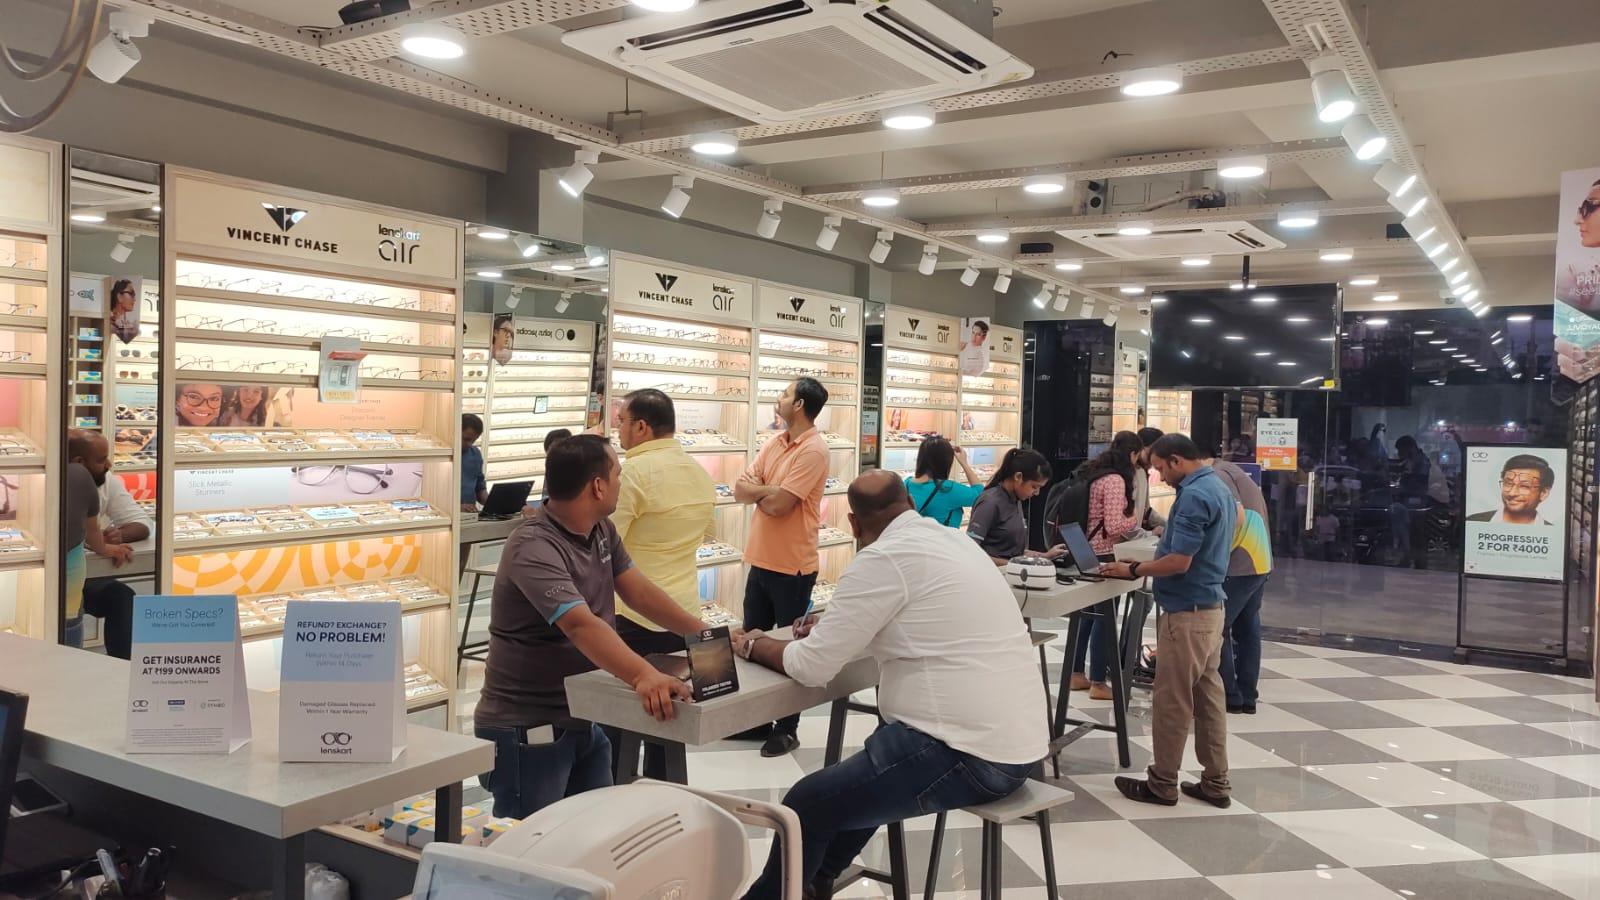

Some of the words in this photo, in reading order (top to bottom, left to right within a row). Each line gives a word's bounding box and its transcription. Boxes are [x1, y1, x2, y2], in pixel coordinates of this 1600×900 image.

[227, 227, 290, 247] VINCENT
[295, 237, 338, 254] CHASE
[378, 239, 420, 265] air
[638, 290, 670, 303] VINCENT
[671, 296, 693, 306] CHASE
[712, 294, 735, 313] air
[776, 312, 799, 322] VINCENT
[799, 315, 815, 325] CHASE
[829, 313, 846, 329] air
[937, 331, 950, 344] air
[1478, 533, 1549, 545] PROGRESSIVE
[1478, 542, 1485, 550] 2
[1487, 543, 1510, 552] FOR
[1512, 544, 1549, 554] ₹4000
[144, 608, 182, 620] Broken
[185, 608, 224, 621] Specs?
[297, 621, 335, 629] REFUND?
[336, 621, 387, 629] EXCHANGE?
[296, 632, 316, 642] NO
[319, 632, 386, 643] PROBLEM!
[142, 656, 162, 665] GET
[164, 655, 222, 664] INSURANCE
[142, 667, 152, 675] AT
[154, 667, 174, 675] ₹199
[175, 666, 221, 675] ONWARDS
